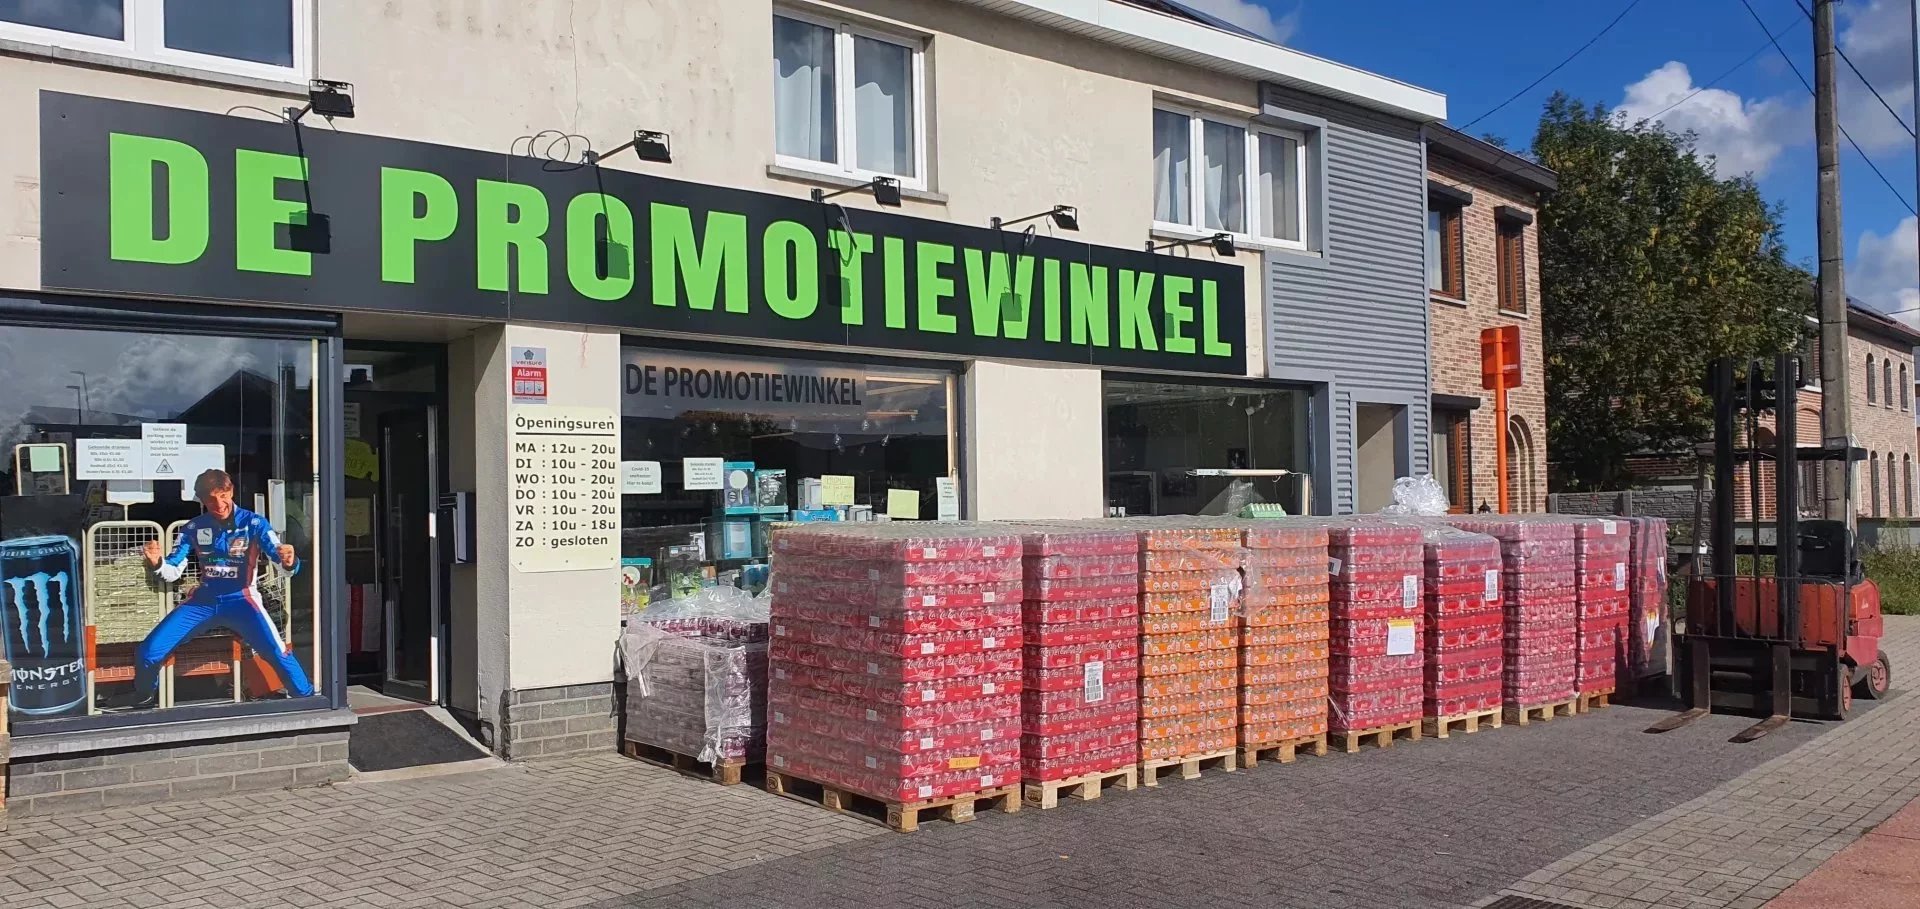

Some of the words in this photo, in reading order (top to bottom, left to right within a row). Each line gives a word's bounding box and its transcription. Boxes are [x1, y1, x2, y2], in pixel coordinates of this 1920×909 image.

[109, 132, 312, 276] DE
[381, 166, 1232, 357] PROMOTIEWINKEL
[517, 368, 542, 378] Alarm
[625, 364, 658, 396] DE
[664, 366, 862, 406] PROMOTIEWINKEL
[516, 416, 614, 431] Openingsuren
[516, 443, 536, 452] MA
[552, 444, 575, 453] 12u
[591, 444, 615, 454] 20u
[516, 459, 532, 468] DI
[552, 459, 575, 469] 10u
[591, 459, 615, 469] 20u
[516, 474, 539, 484] WO
[552, 475, 575, 484] 10u
[591, 475, 615, 484] 20u
[516, 490, 536, 499] DO
[552, 490, 576, 499] 10u
[592, 490, 615, 499] 20u
[516, 505, 534, 515] VR
[552, 505, 576, 514] 10u
[592, 505, 615, 514] 20u
[516, 521, 534, 530] ZA
[552, 521, 576, 530] 10u
[592, 520, 615, 530] 18u
[516, 537, 534, 547] ZO
[551, 536, 608, 548] gesloten
[16, 676, 78, 690] ENERGY
